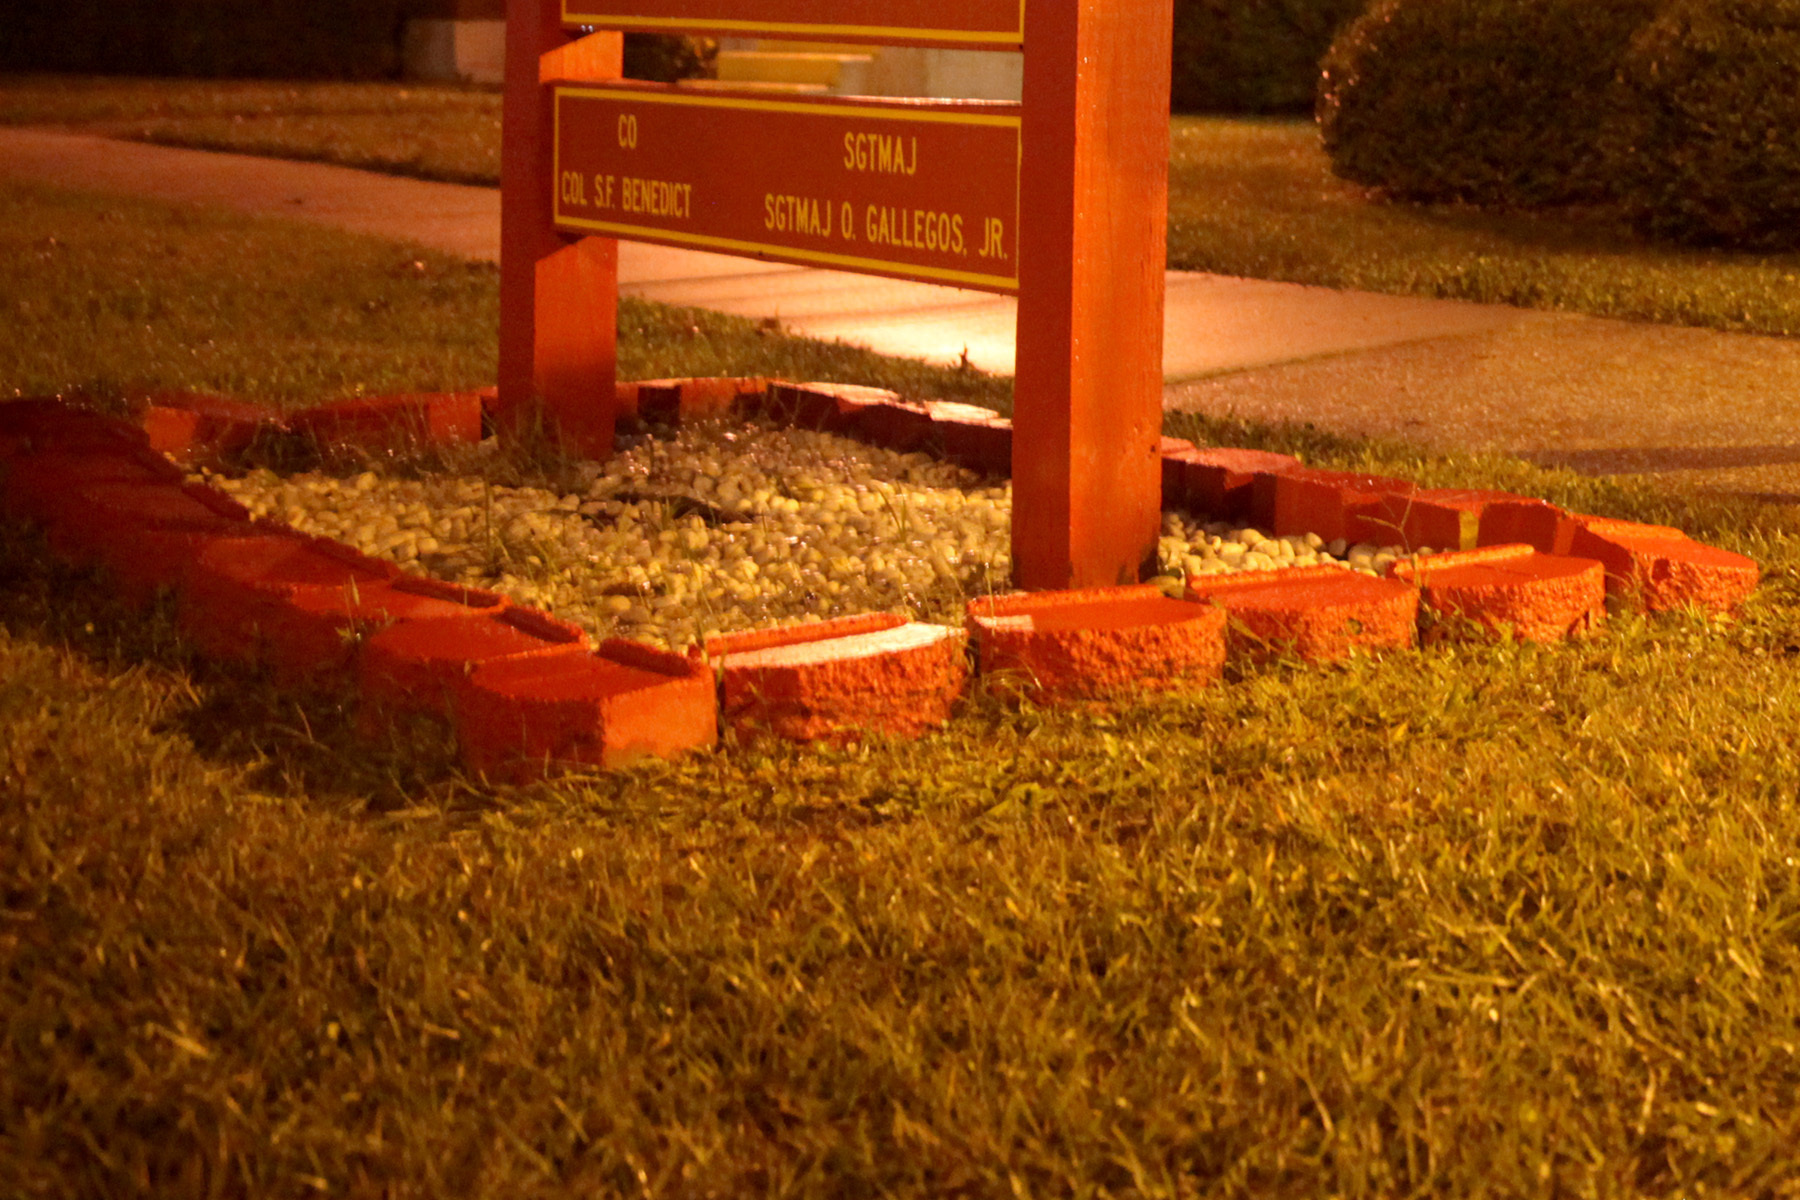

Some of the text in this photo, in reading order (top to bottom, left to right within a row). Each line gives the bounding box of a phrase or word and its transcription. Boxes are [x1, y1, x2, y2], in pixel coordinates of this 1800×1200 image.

[617, 113, 638, 150] CO
[843, 131, 917, 176] SGTMAJ
[561, 170, 588, 206] COL
[622, 176, 692, 218] BENEDICT
[764, 192, 832, 238] SGTMAJ
[840, 201, 856, 241] O.
[978, 217, 1008, 260] JR.
